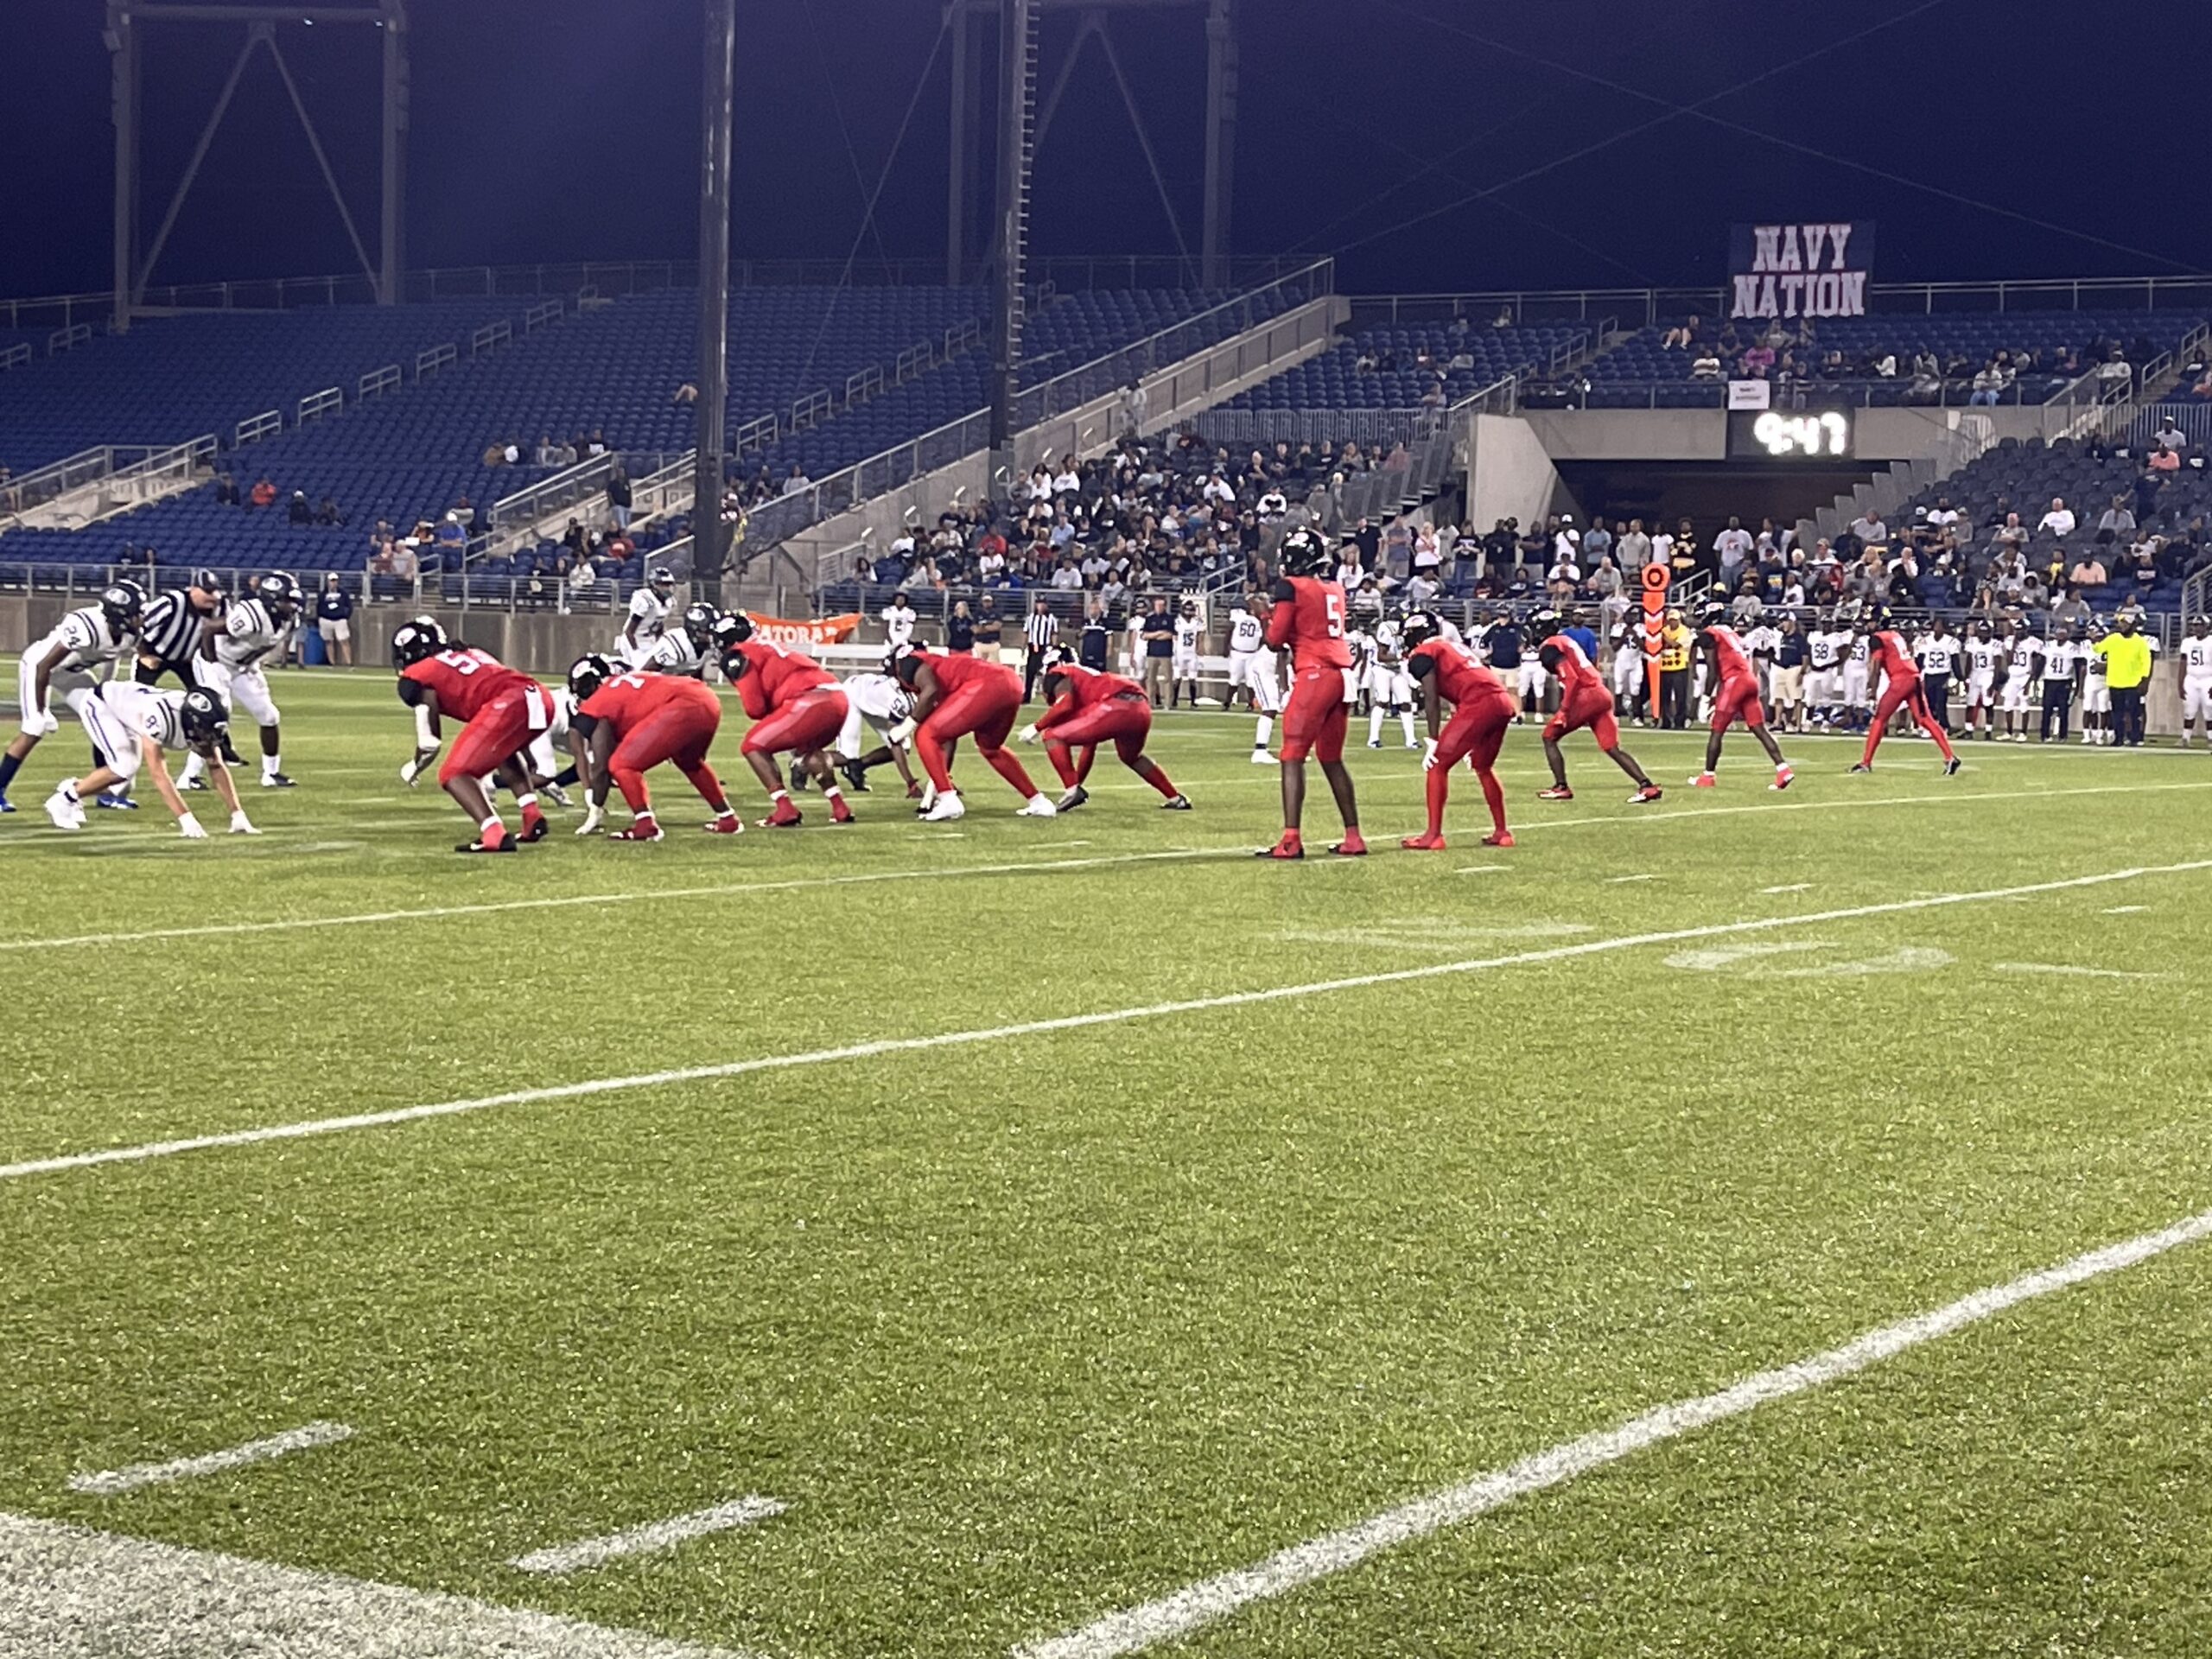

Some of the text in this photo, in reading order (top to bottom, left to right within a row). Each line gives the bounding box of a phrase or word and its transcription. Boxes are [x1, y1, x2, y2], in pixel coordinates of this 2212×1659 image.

[1752, 223, 1852, 272] NAVY
[1731, 271, 1866, 319] NATION
[1754, 411, 1847, 454] 9:47
[1325, 594, 1342, 637] 5
[63, 626, 82, 649] 24
[1239, 622, 1256, 638] 60
[1929, 652, 1944, 668] 52
[1974, 655, 1987, 668] 13
[2050, 658, 2063, 674] 41
[2191, 650, 2204, 666] 51
